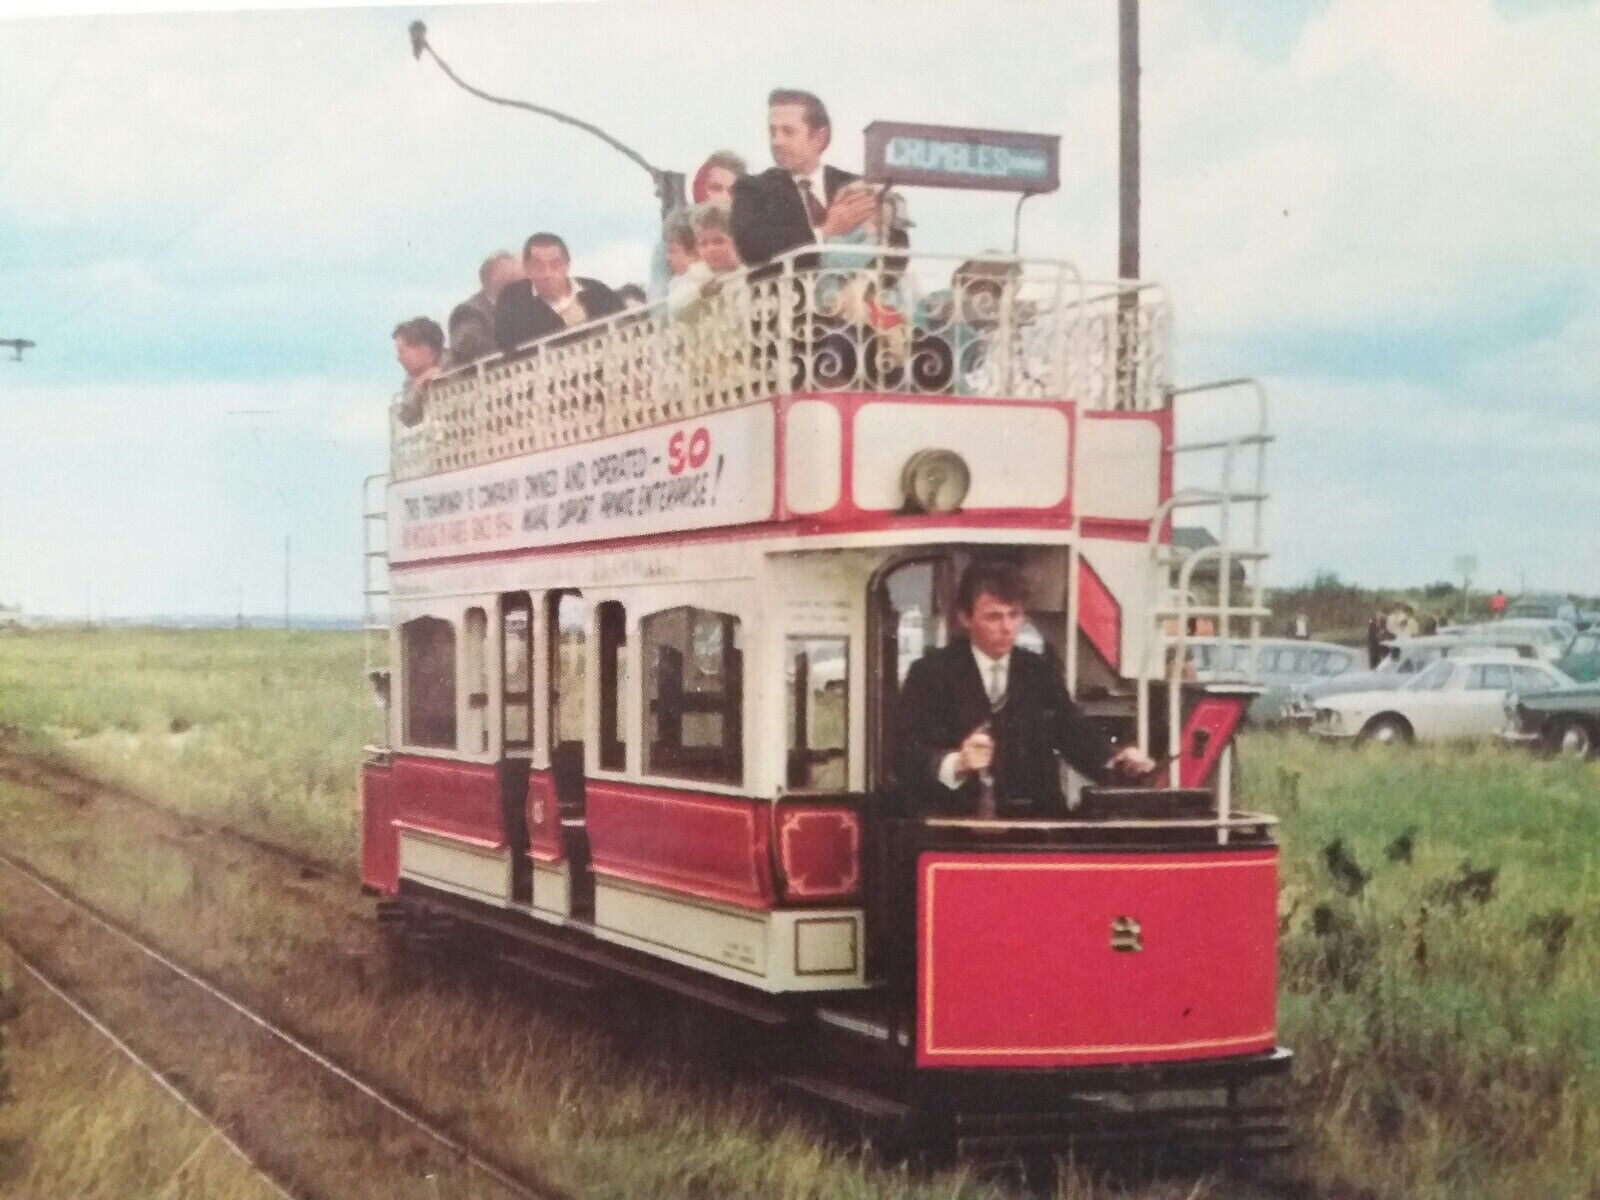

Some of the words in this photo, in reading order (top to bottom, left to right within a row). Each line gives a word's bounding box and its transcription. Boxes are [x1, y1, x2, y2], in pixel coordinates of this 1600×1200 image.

[886, 137, 1009, 176] CRUMBLES
[525, 469, 558, 500] OWNED
[563, 461, 586, 492] AND
[591, 447, 648, 486] OPERATED
[667, 427, 711, 476] SO
